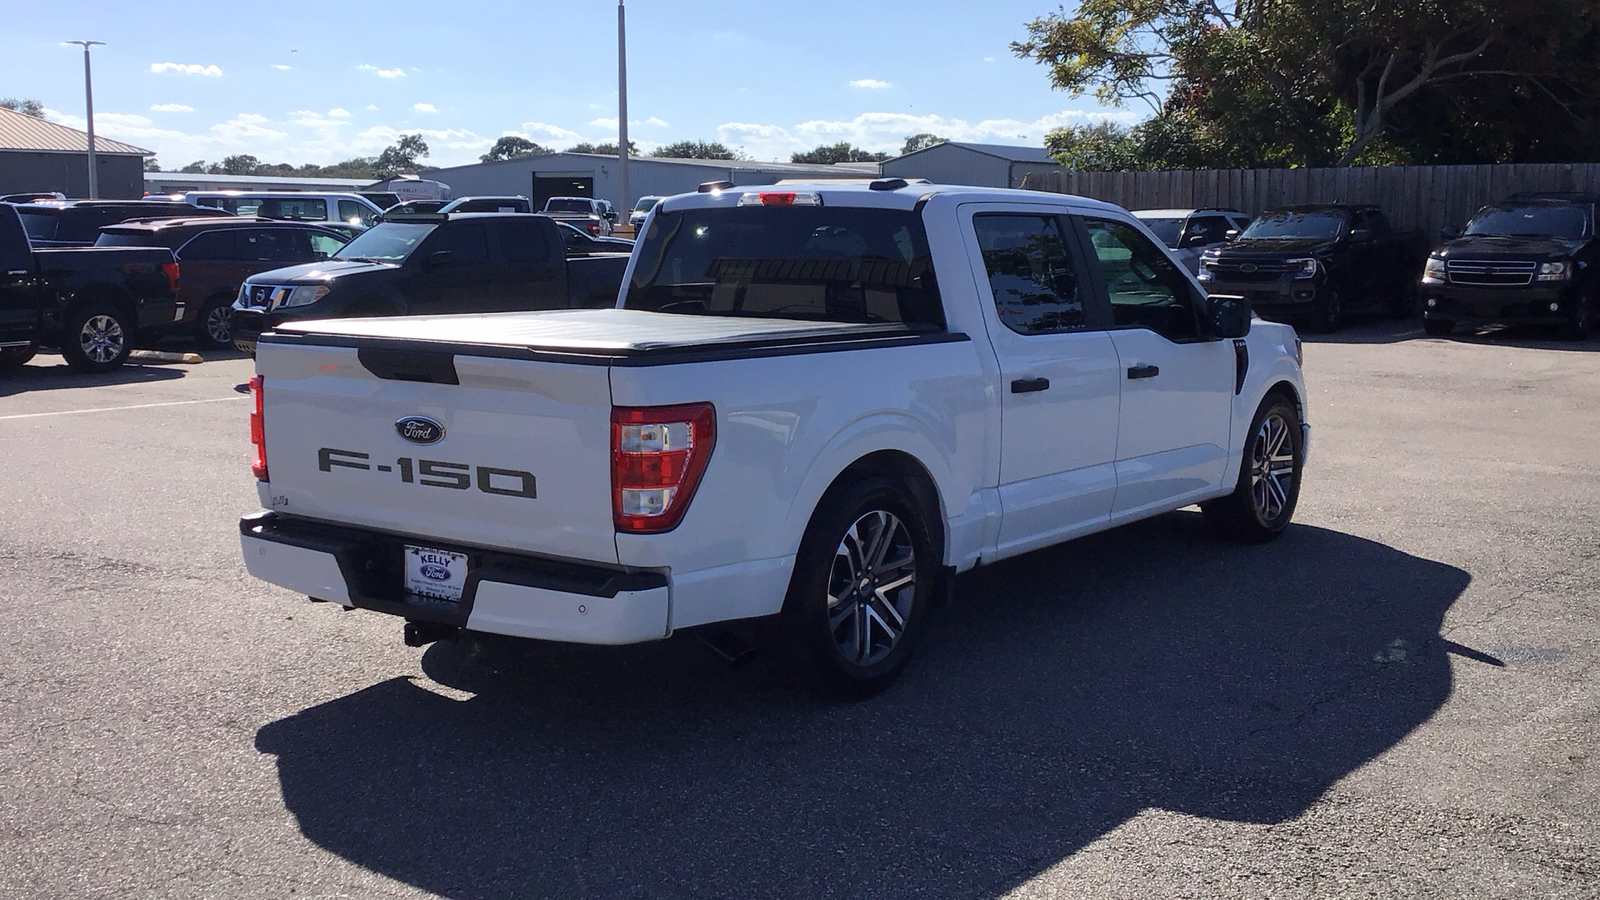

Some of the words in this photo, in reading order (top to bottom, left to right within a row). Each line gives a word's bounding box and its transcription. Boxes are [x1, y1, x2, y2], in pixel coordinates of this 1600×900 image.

[404, 420, 432, 440] Ford
[318, 447, 538, 500] F-150
[420, 554, 451, 567] KELLY
[425, 566, 446, 580] Ford
